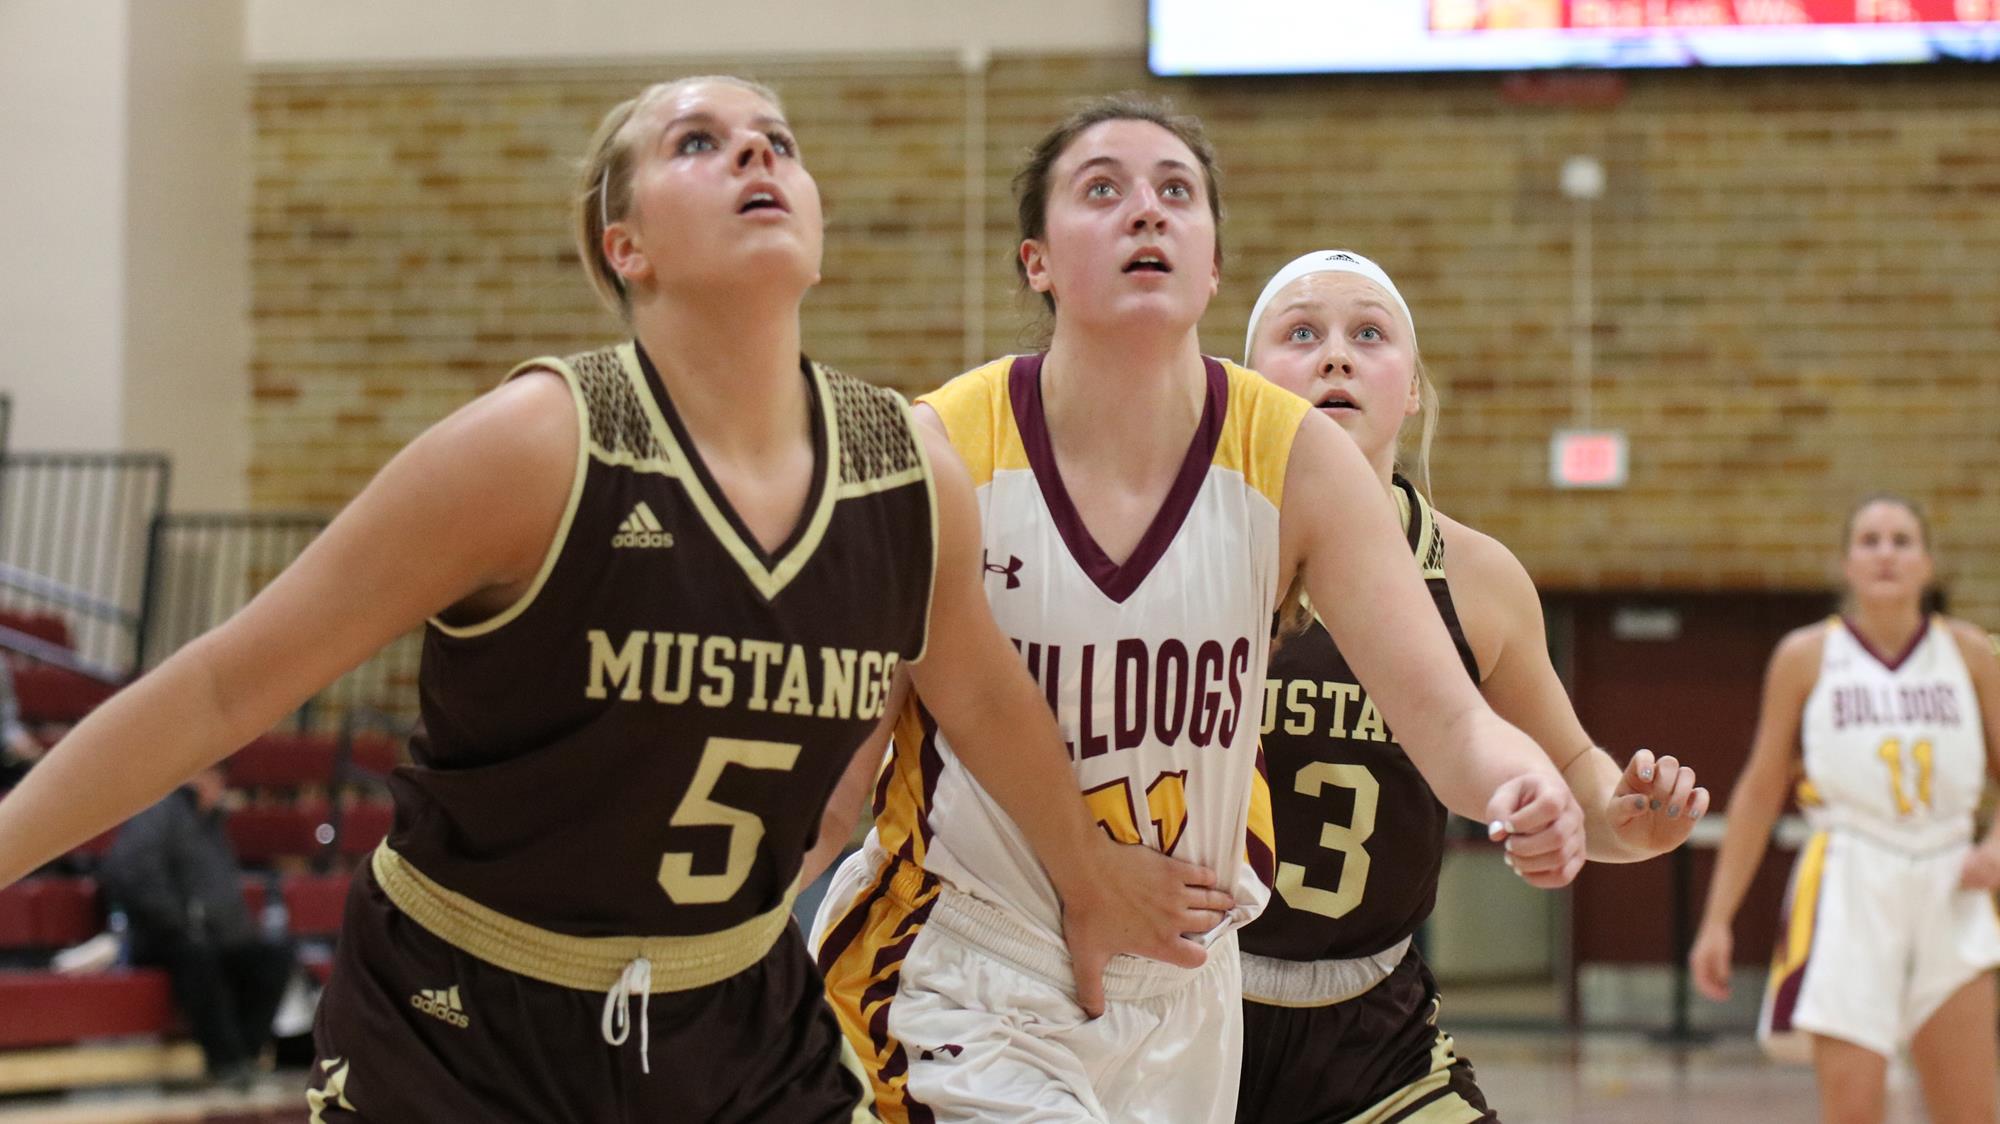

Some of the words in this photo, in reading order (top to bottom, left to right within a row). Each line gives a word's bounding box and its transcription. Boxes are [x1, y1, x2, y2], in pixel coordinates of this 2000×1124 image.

[611, 532, 674, 548] adidas
[1009, 636, 1250, 761] LLDOGS
[1259, 679, 1399, 744] USTA
[1877, 735, 1933, 816] 11
[657, 736, 802, 905] 5
[1275, 760, 1380, 919] 3
[410, 994, 470, 1028] adidas
